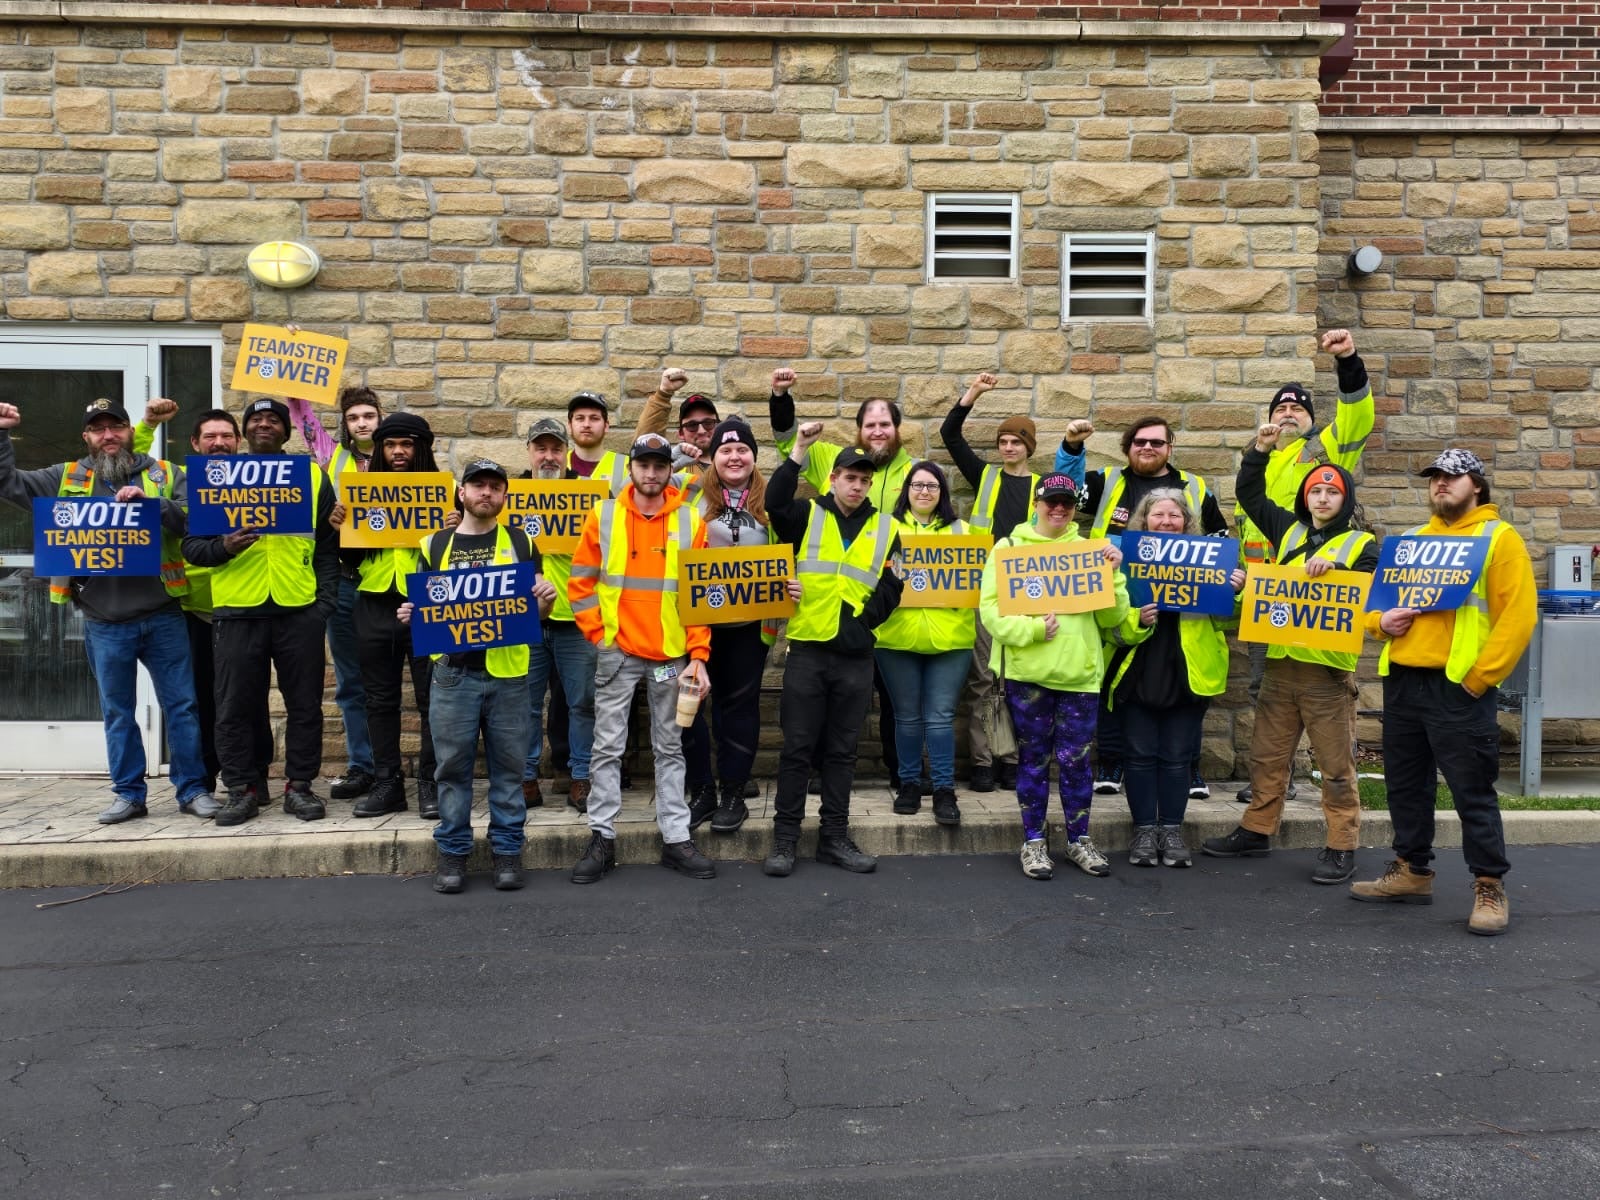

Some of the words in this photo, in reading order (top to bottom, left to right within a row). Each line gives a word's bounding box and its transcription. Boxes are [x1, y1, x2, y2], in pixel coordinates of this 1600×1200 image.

[248, 336, 338, 365] TEAMSTER
[225, 460, 292, 485] VOTE
[197, 487, 302, 503] TEAMSTERS
[346, 485, 446, 503] TEAMSTER
[73, 501, 142, 527] VOTE
[224, 507, 276, 528] YES!
[43, 529, 151, 545] TEAMSTERS
[69, 548, 124, 569] YES!
[902, 547, 987, 564] EAMSTER
[1002, 551, 1104, 572] TEAMSTER
[1153, 539, 1222, 565] VOTE
[1407, 541, 1473, 567] VOTE
[685, 559, 788, 581] TEAMSTER
[1128, 562, 1226, 584] TEAMSTERS
[1382, 567, 1471, 585] TEAMSTERS
[448, 570, 516, 600] VOTE
[1150, 581, 1198, 606] YES!
[1253, 577, 1361, 604] TEAMSTER
[1396, 586, 1442, 608] YES!
[419, 597, 528, 623] TEAMSTERS
[448, 620, 503, 645] YES!
